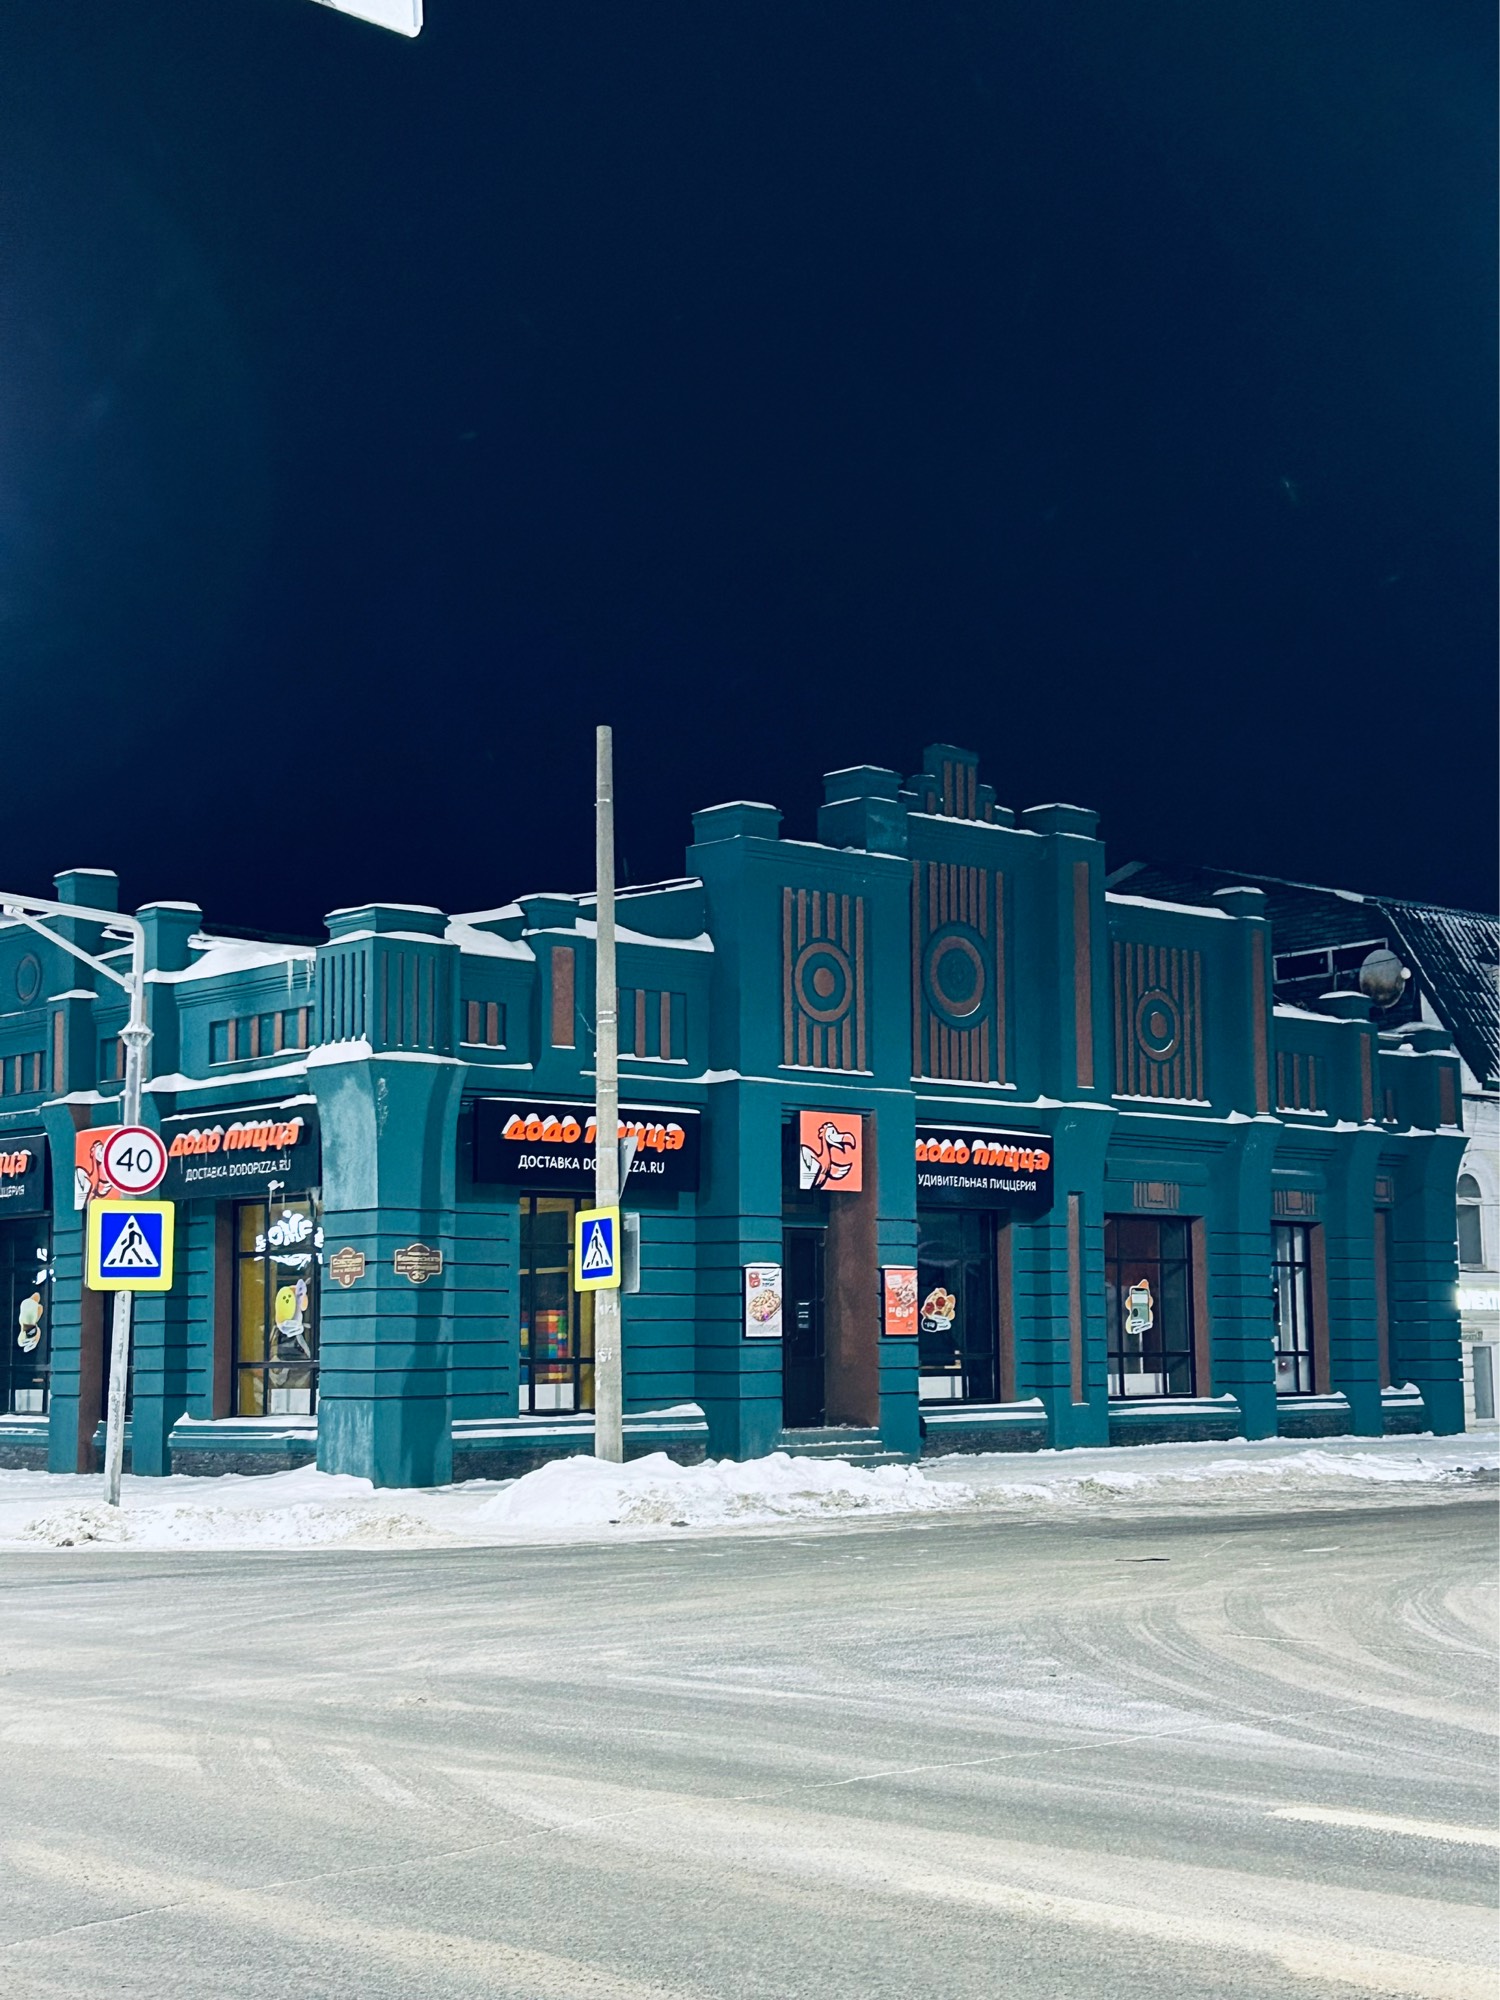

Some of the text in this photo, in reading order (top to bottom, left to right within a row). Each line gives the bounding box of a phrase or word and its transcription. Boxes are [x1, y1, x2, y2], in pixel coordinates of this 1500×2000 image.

[116, 1147, 153, 1173] 40
[518, 1154, 580, 1170] ДОСТАВКА
[185, 1167, 227, 1182] ДОСТАВКА
[918, 1174, 1036, 1192] УДИВИТЕЛЬНАЯ ПИЦЦЕРИЯ
